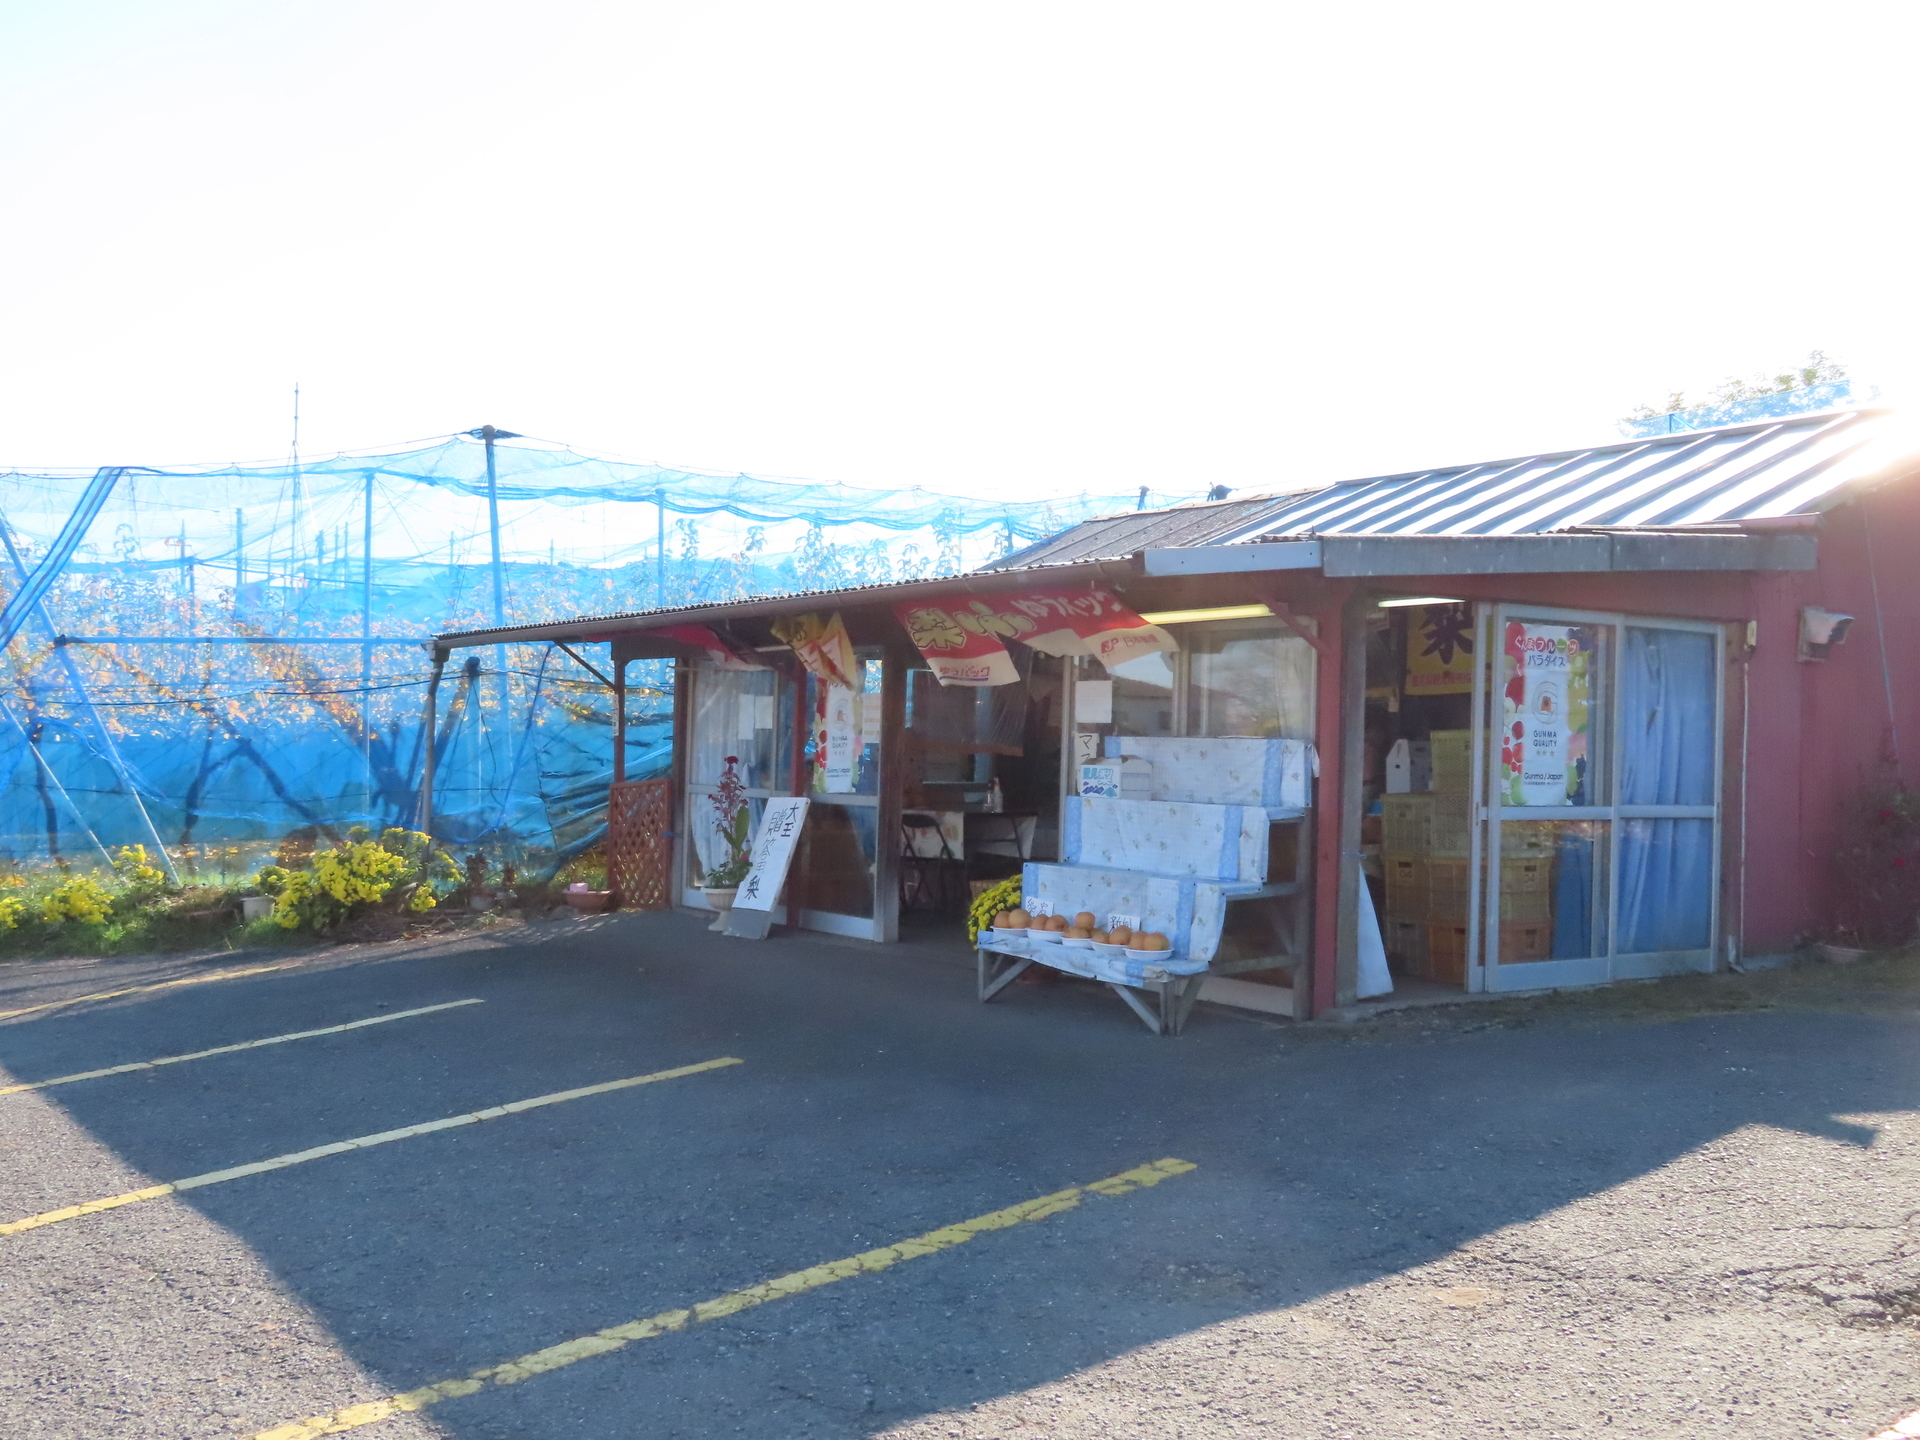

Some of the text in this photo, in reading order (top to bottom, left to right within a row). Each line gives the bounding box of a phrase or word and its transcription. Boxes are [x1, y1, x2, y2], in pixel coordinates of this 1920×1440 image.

[905, 608, 967, 651] 梨
[1515, 635, 1580, 656] ぐんまフルーツ
[1527, 654, 1566, 667] パラダイス
[939, 664, 991, 678] ゆうパック
[1533, 730, 1558, 738] GUNMA
[1533, 739, 1558, 748] QUALITY
[780, 802, 799, 837] 大玉
